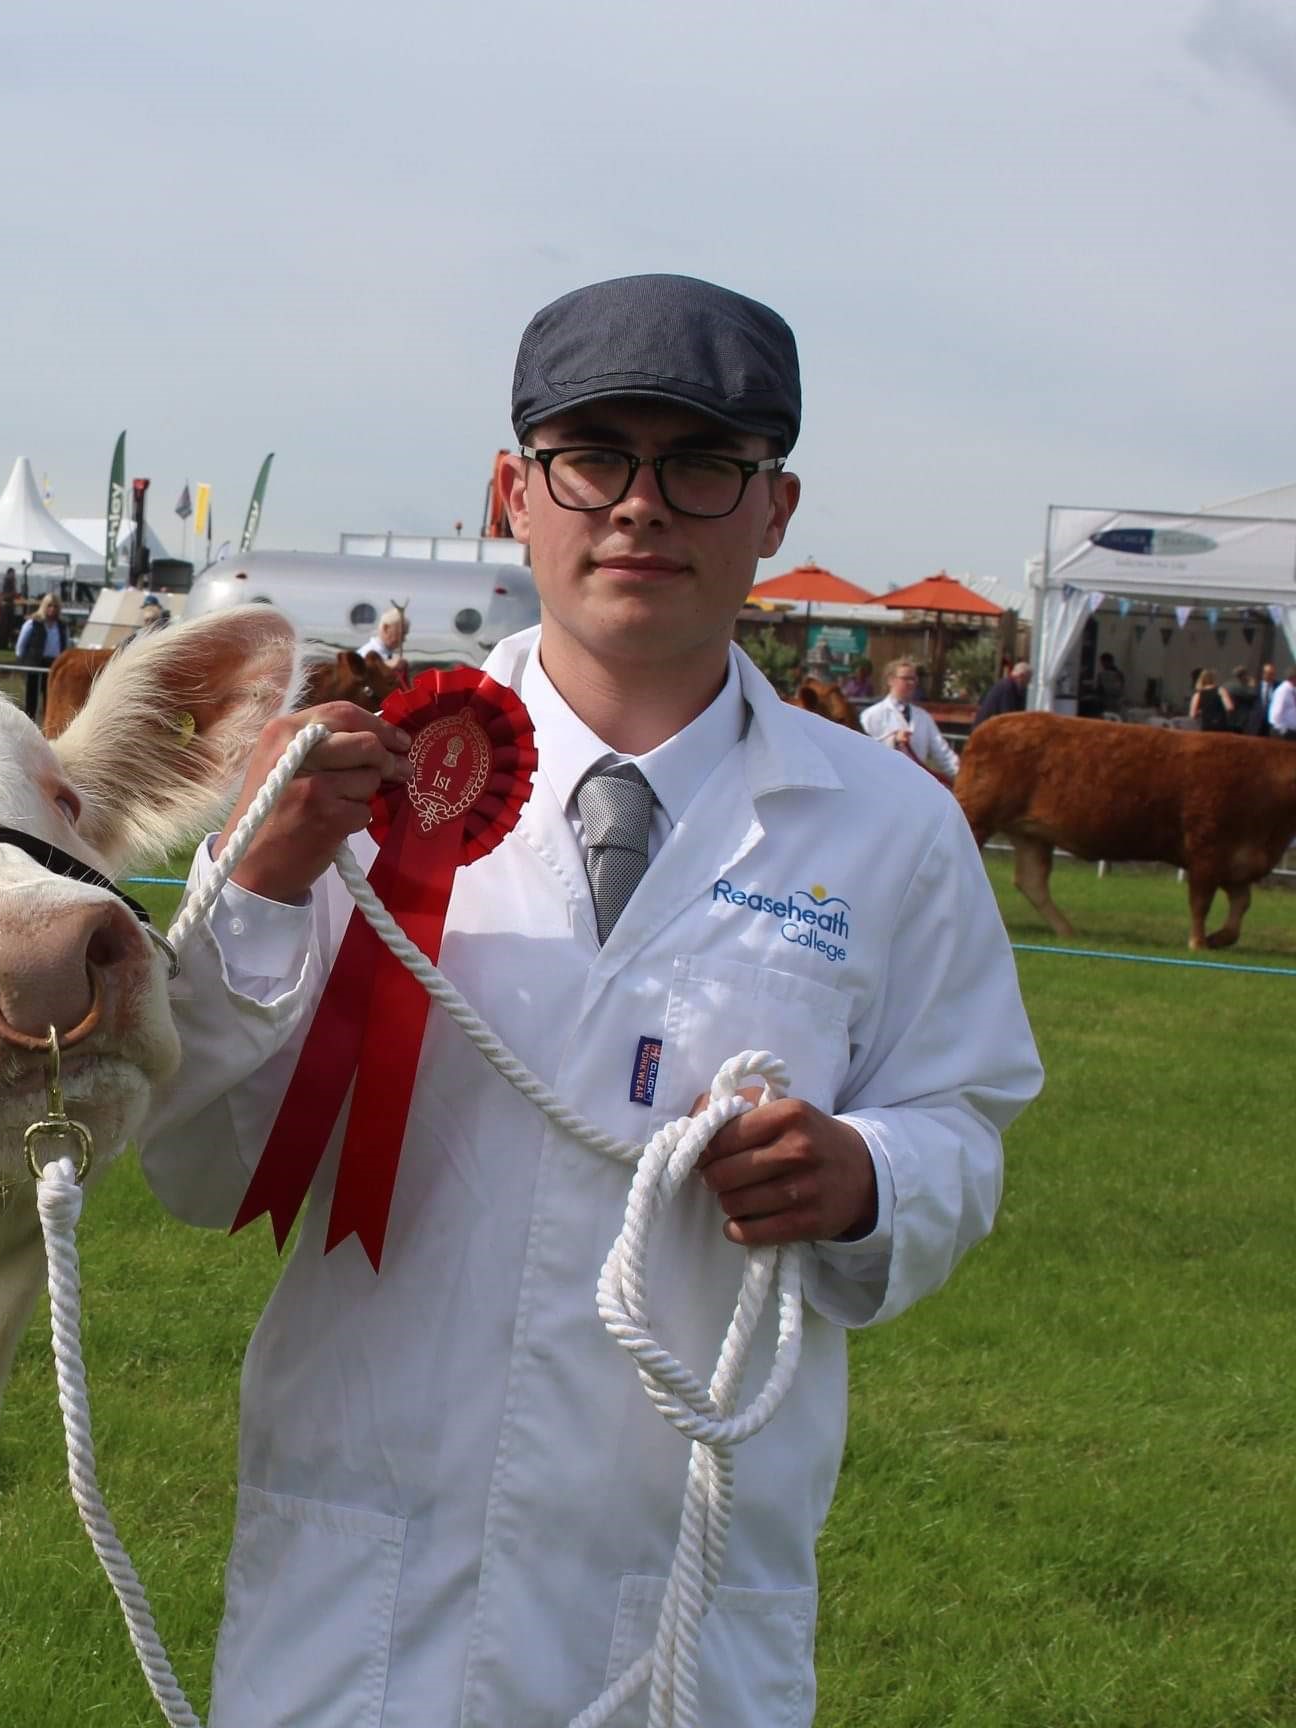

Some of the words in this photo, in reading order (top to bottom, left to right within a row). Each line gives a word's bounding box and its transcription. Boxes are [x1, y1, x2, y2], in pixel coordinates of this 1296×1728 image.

[432, 770, 451, 790] 1st
[712, 879, 849, 939] Reaseheath
[781, 923, 846, 961] College
[635, 1044, 650, 1099] WORKWEAR
[647, 1062, 657, 1096] CLICK
